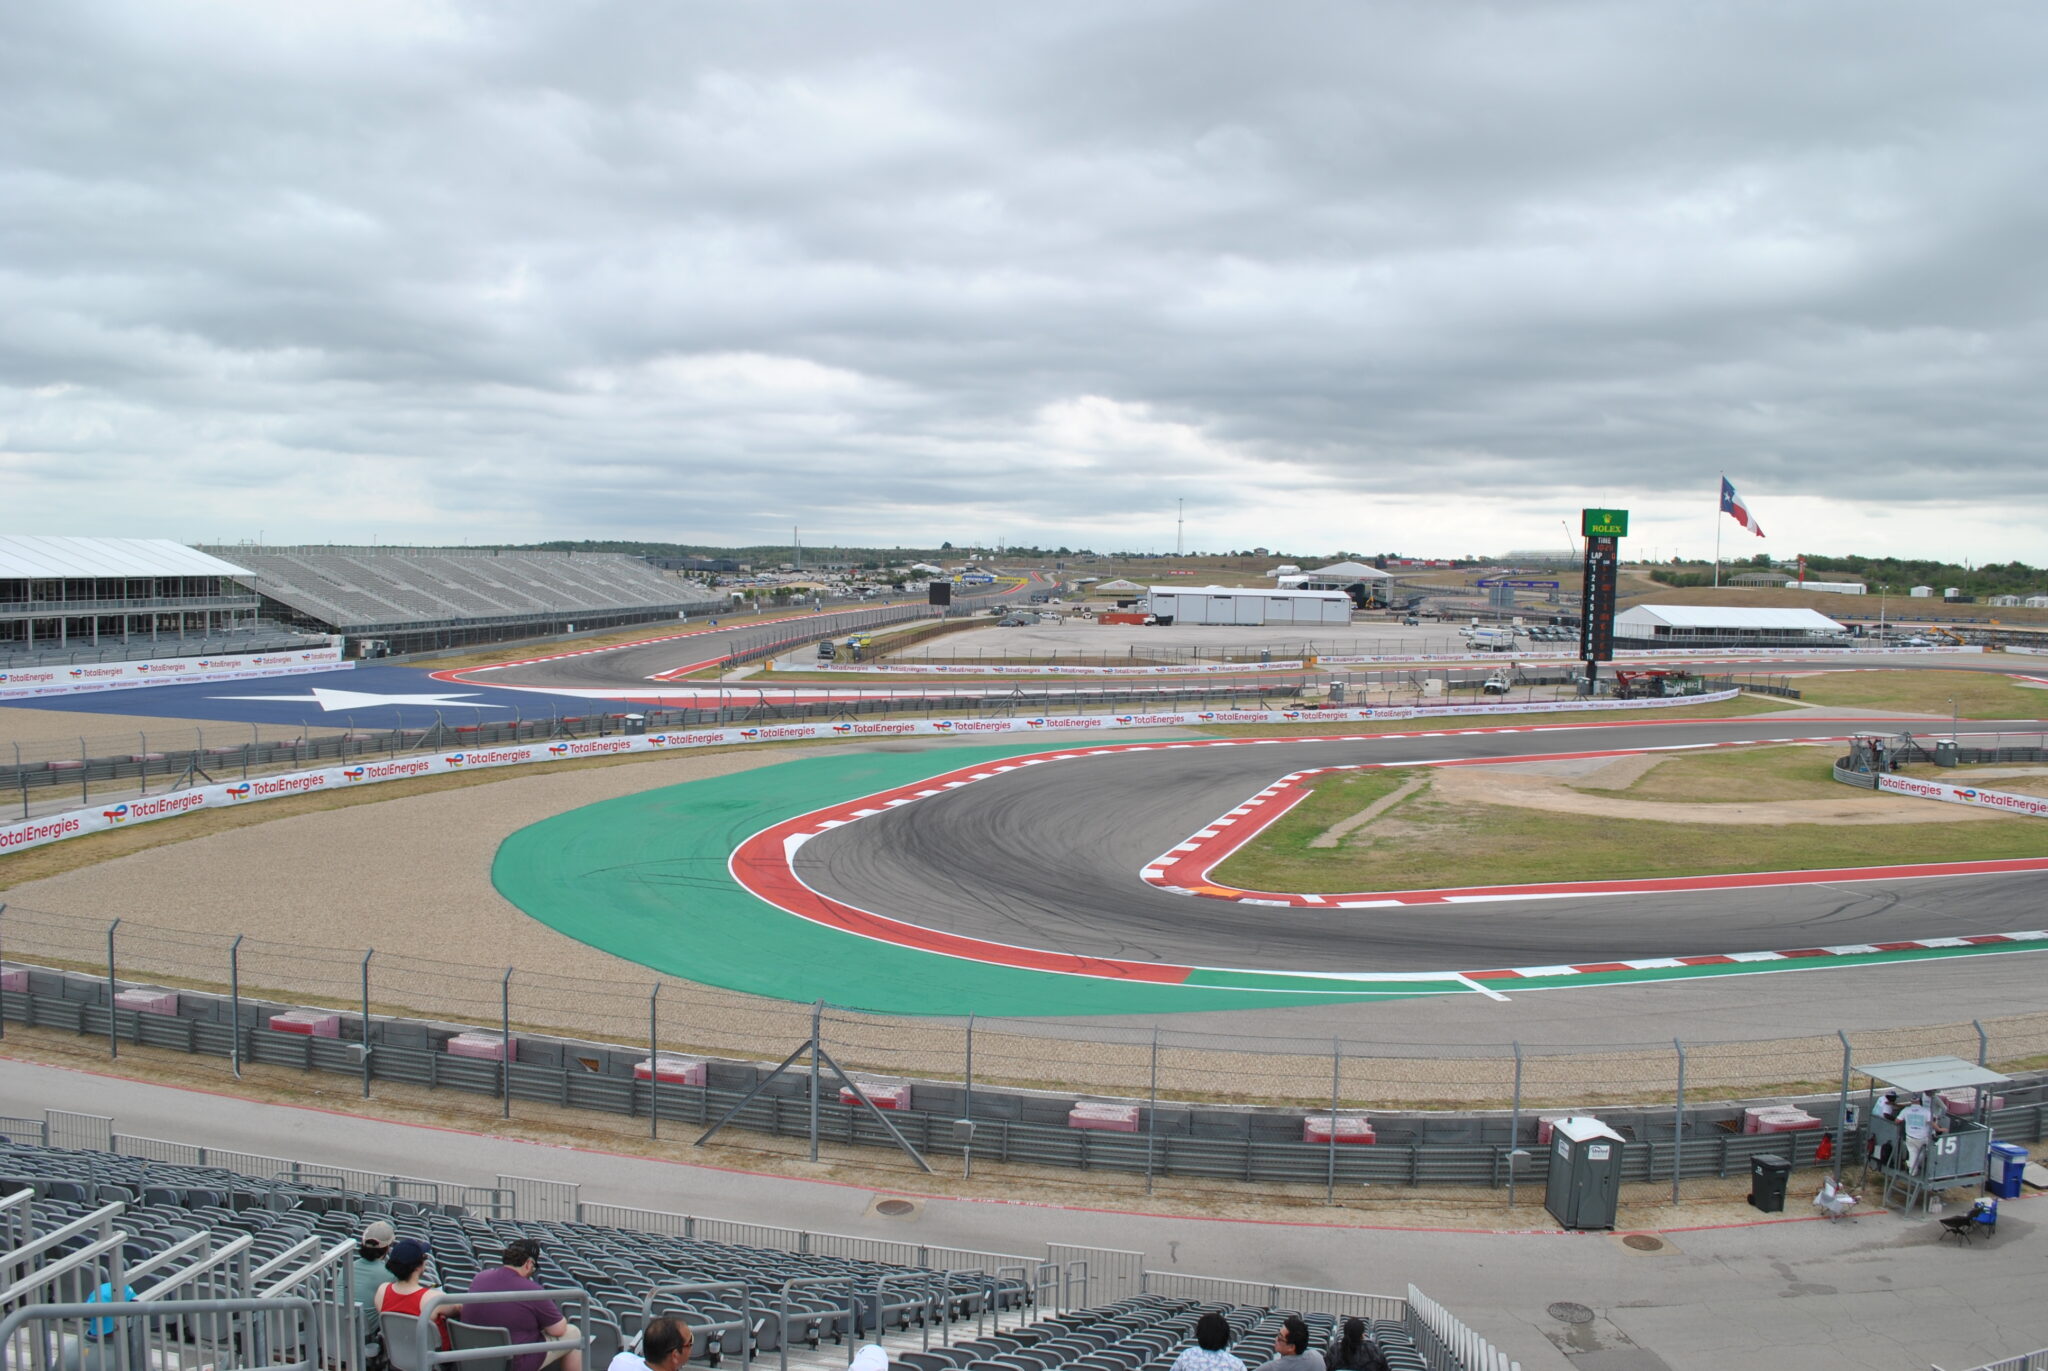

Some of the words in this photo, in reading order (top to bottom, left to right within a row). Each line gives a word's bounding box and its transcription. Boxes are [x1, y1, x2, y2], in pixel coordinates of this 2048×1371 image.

[1592, 524, 1621, 532] ROLEX
[84, 668, 123, 677] TotalEnergies
[150, 663, 186, 672] TotalEnergies
[9, 672, 54, 682] TotalEnergies
[1215, 712, 1268, 725] TotalEnergies
[1300, 710, 1348, 723] TotalEnergies
[1374, 707, 1412, 719] TotalEnergies
[954, 720, 1011, 733] TotalEnergies
[1046, 718, 1101, 730] TotalEnergies
[1134, 714, 1184, 727] TotalEnergies
[760, 727, 815, 740] TotalEnergies
[854, 722, 915, 736] TotalEnergies
[667, 731, 724, 746] TotalEnergies
[570, 738, 631, 755] TotalEnergies
[466, 748, 531, 766] TotalEnergies
[367, 760, 429, 779] TotalEnergies
[253, 775, 324, 795] TotalEnergies
[1880, 776, 1942, 796] TotalEnergies
[130, 793, 203, 817] TotalEnergies
[1978, 792, 2048, 814] TotalEnergie
[1935, 1136, 1957, 1156] 15
